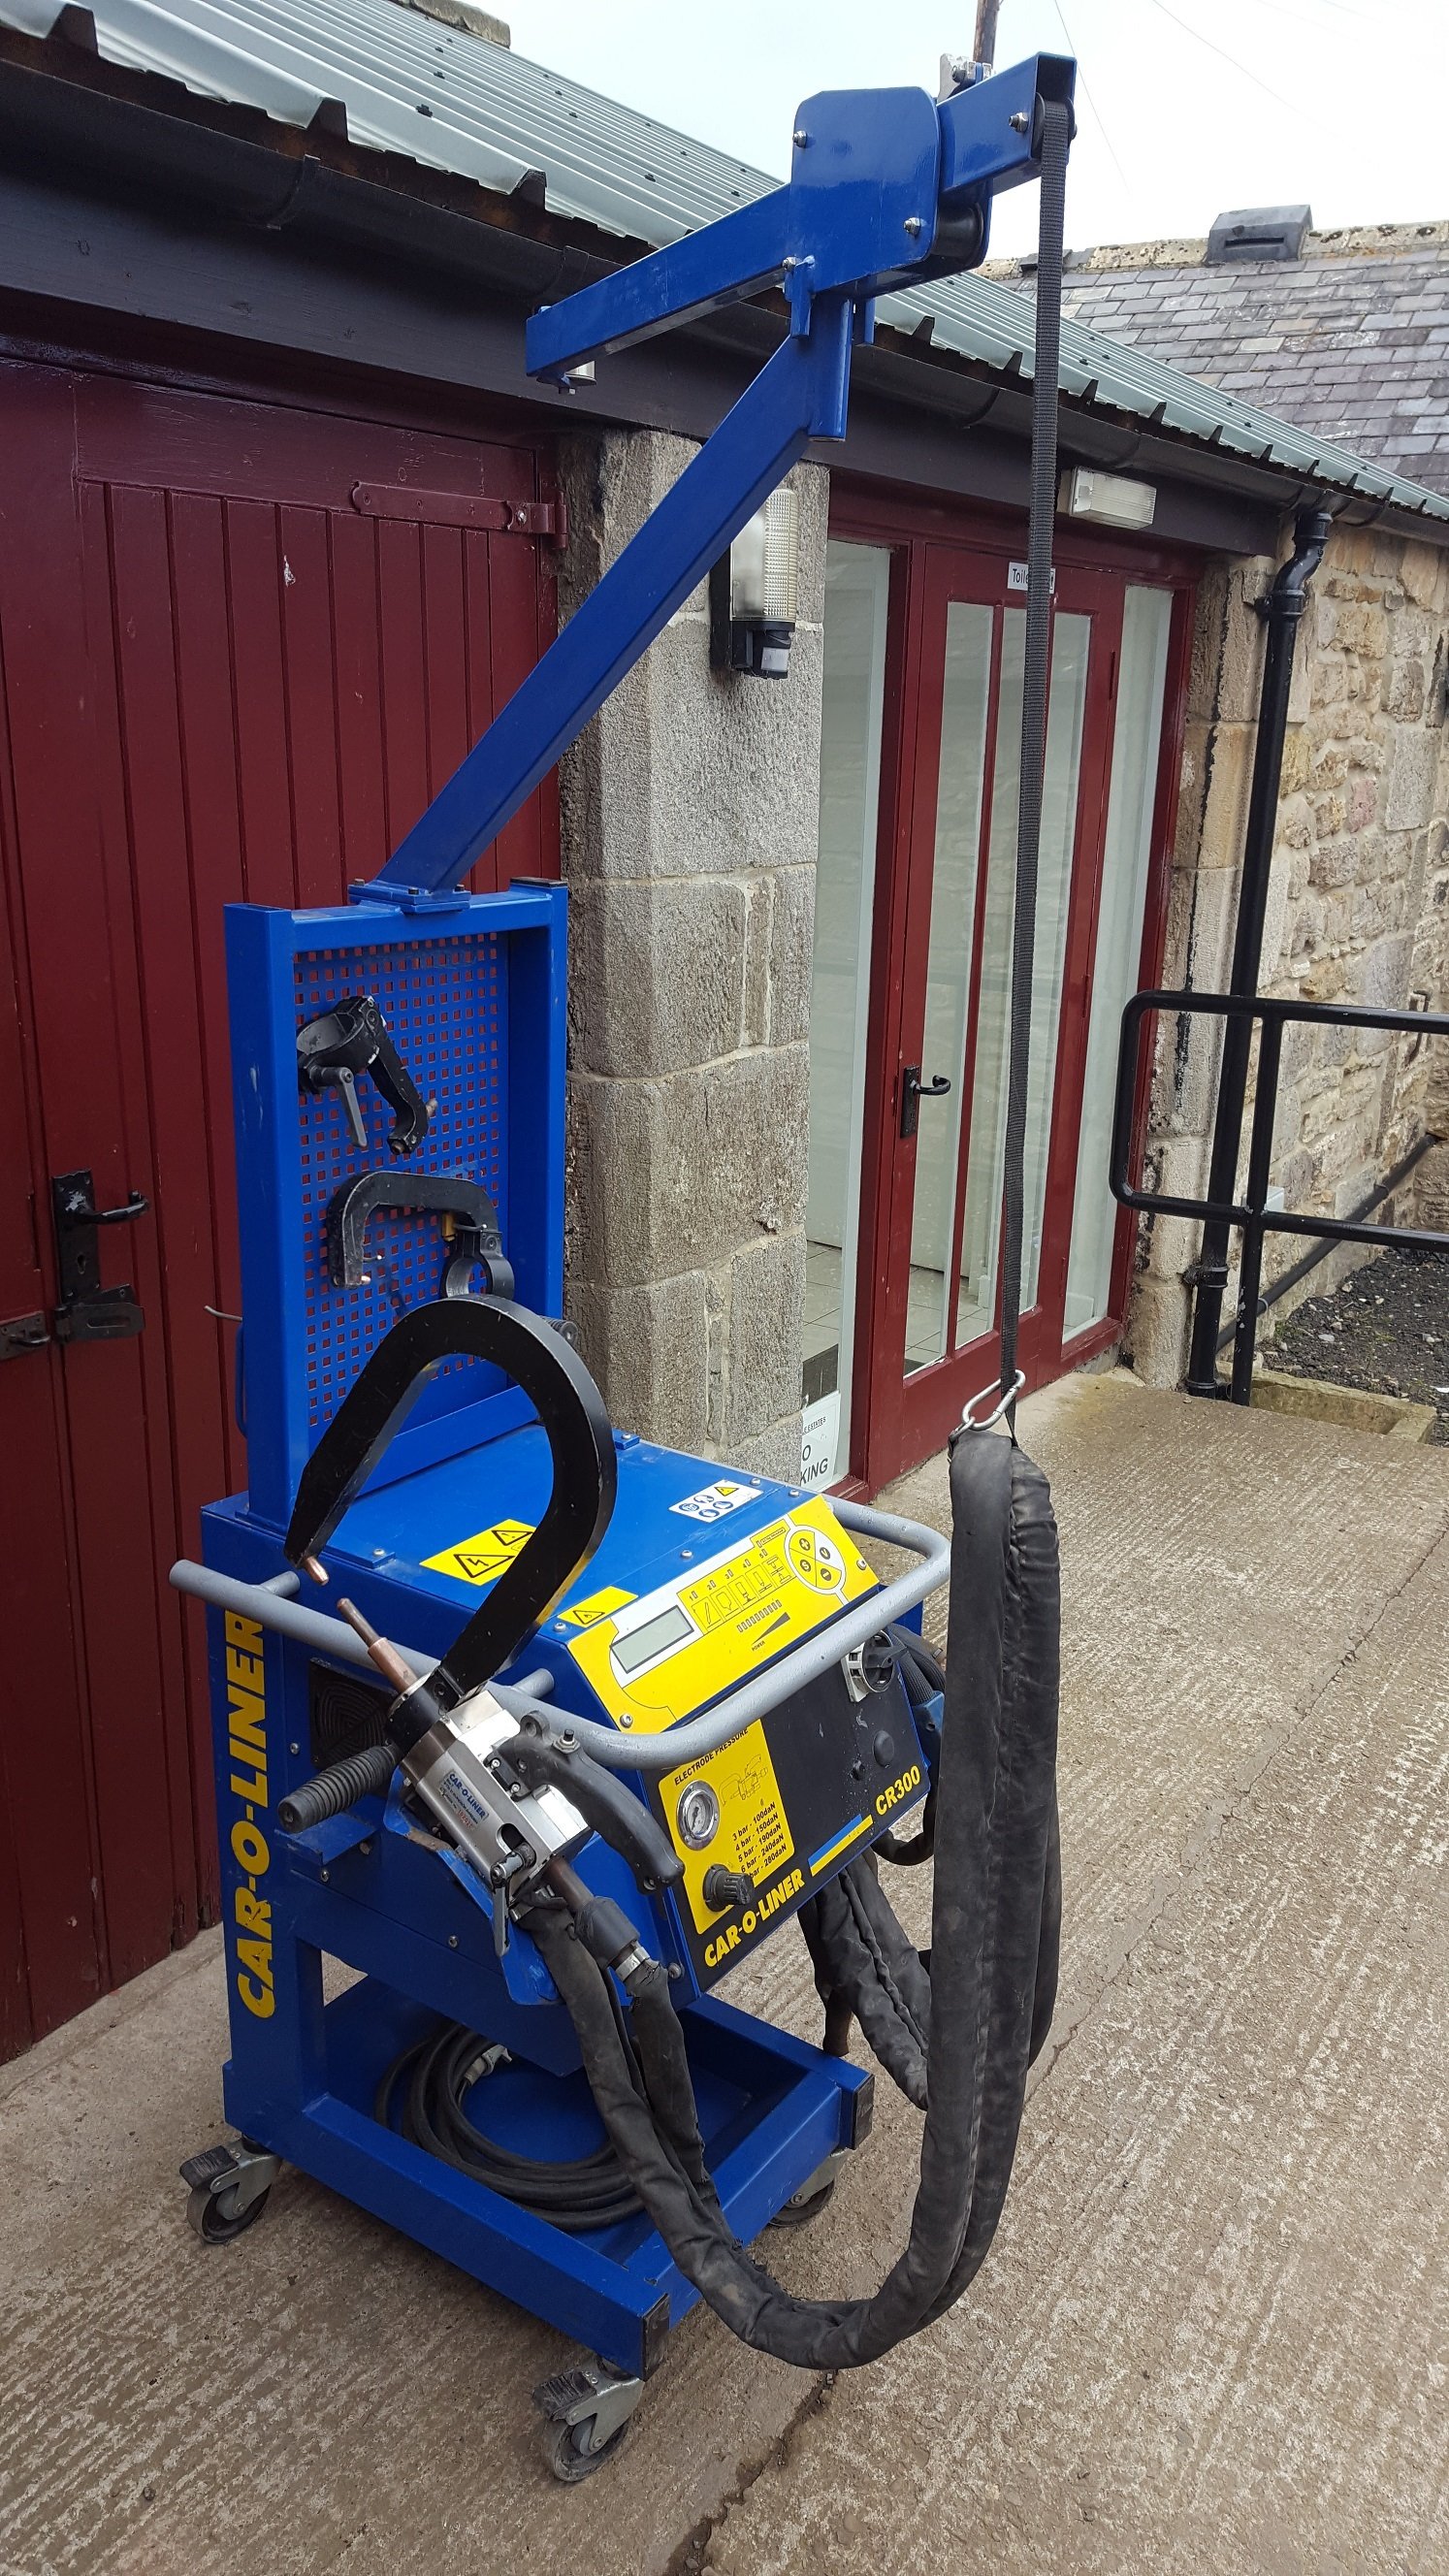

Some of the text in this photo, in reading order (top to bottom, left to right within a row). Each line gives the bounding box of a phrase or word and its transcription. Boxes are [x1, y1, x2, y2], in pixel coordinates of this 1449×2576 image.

[807, 1416, 826, 1433] ESTATES
[802, 1444, 811, 1462] O
[674, 1728, 749, 1786] ELECTRODE PRESSURE
[449, 1773, 486, 1819] CAR-O-LINER
[875, 1765, 920, 1816] CR300
[224, 1609, 275, 2019] CAR-O-LINER
[735, 1843, 740, 1852] 4
[741, 1835, 751, 1848] bar
[756, 1812, 779, 1834] 150daN
[738, 1824, 748, 1837] bar
[753, 1801, 776, 1824] 100daN
[738, 1853, 743, 1862] 5
[744, 1846, 754, 1858] bar
[758, 1822, 782, 1845] 190daN
[746, 1856, 757, 1869] bar
[761, 1833, 784, 1855] 240daN
[763, 1843, 787, 1867] 280daN
[703, 1868, 806, 1968] CAR-O-LINER
